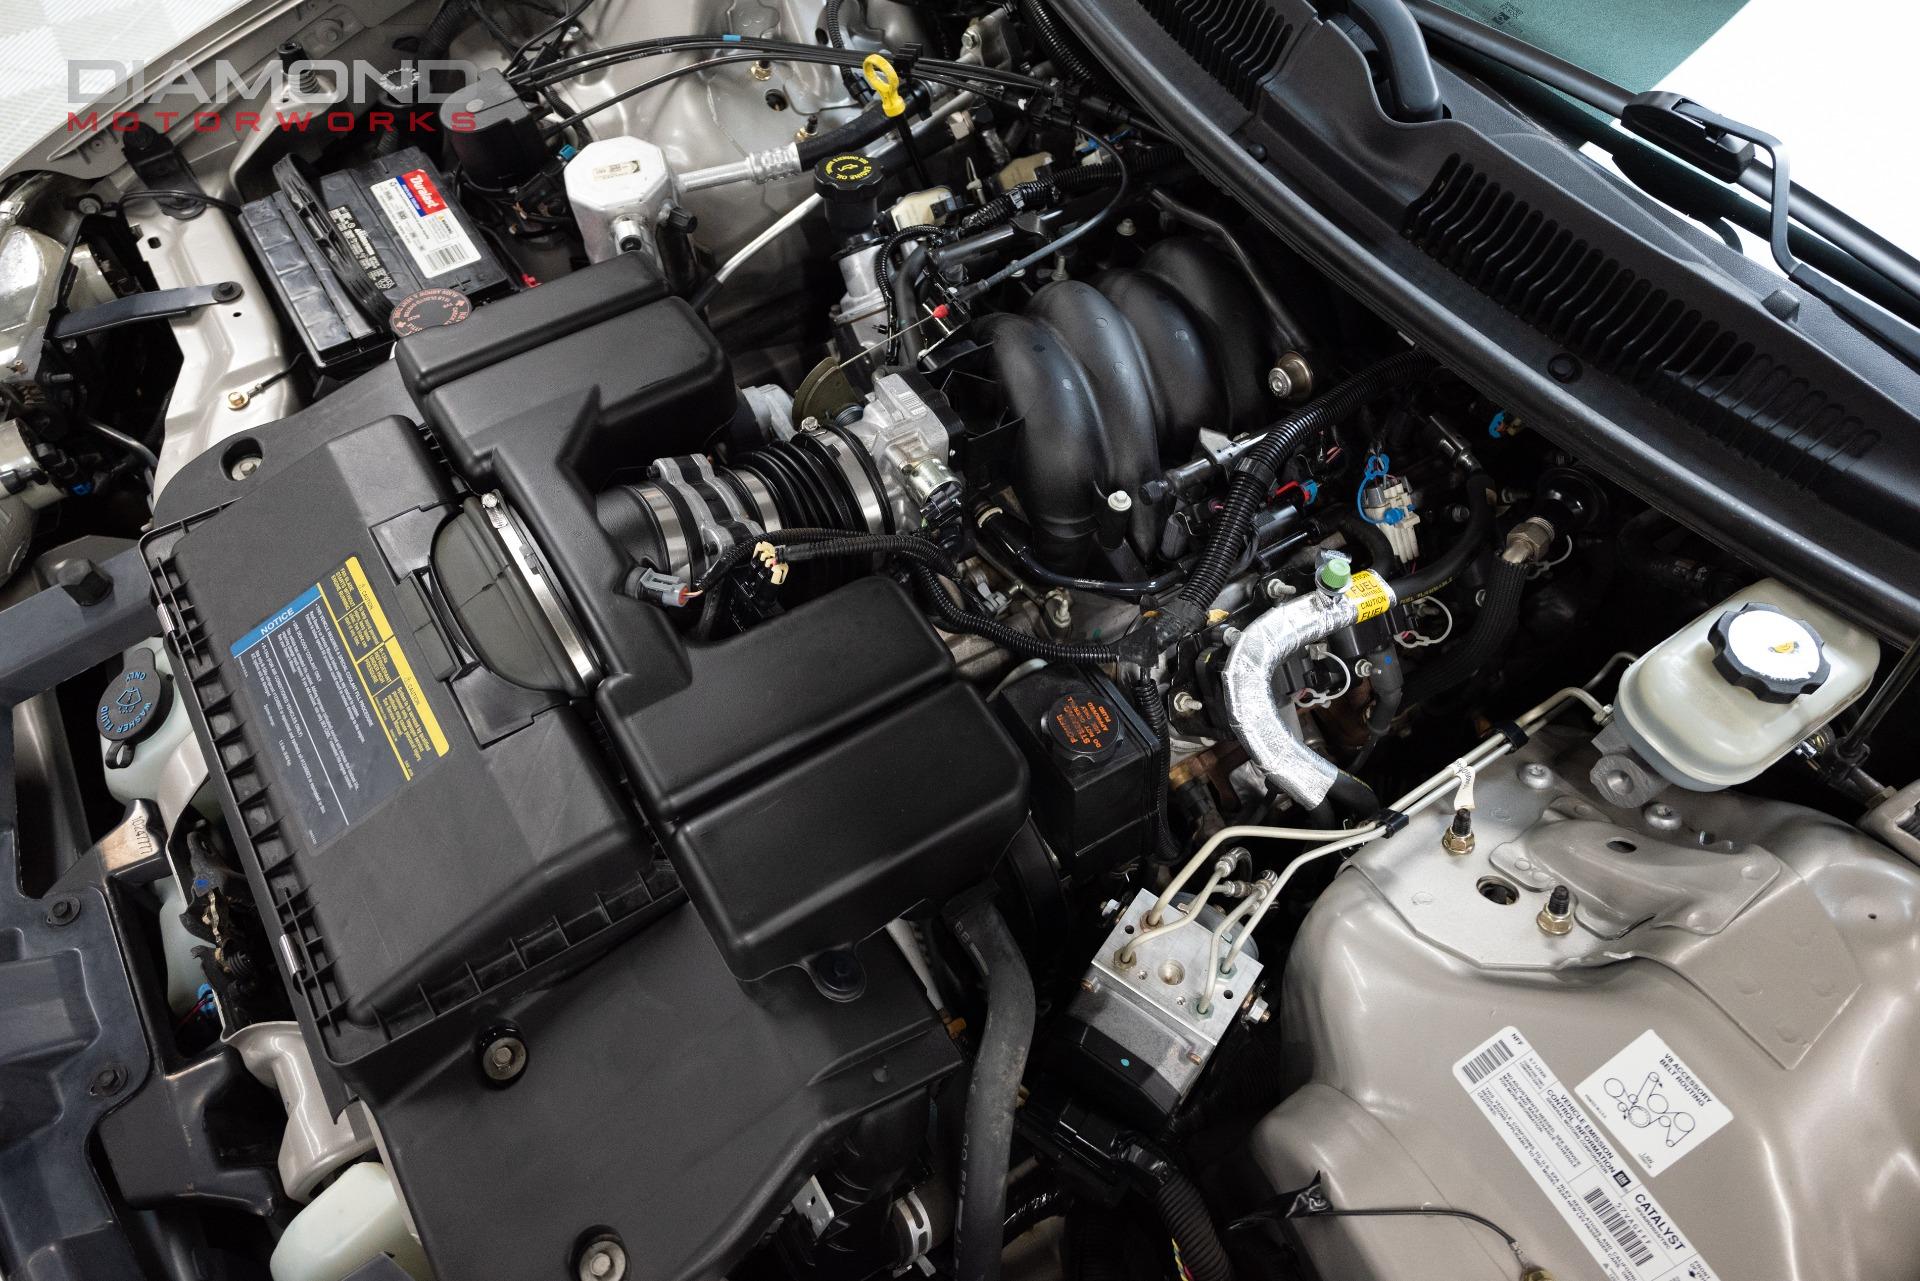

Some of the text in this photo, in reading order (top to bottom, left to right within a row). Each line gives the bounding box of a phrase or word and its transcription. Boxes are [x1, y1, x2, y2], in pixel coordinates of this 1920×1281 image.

[410, 174, 440, 208] Duralast
[361, 589, 373, 610] CAUTION
[1351, 580, 1378, 595] FUEL
[1360, 595, 1387, 610] CAUTION
[260, 607, 294, 635] NOTICE
[125, 671, 147, 683] ONLY
[407, 683, 420, 706] CAUTION
[101, 702, 153, 734] WASHER FLUID
[1658, 1058, 1706, 1107] BELT ROUTING
[1663, 1053, 1712, 1103] V8 ACCESSORY
[1546, 1088, 1574, 1122] CONTROL
[1574, 1123, 1616, 1173] INFORMATION
[1559, 1094, 1585, 1124] VEHICLE
[1583, 1124, 1614, 1159] EMISSION
[1633, 1191, 1686, 1253] CATALYST
